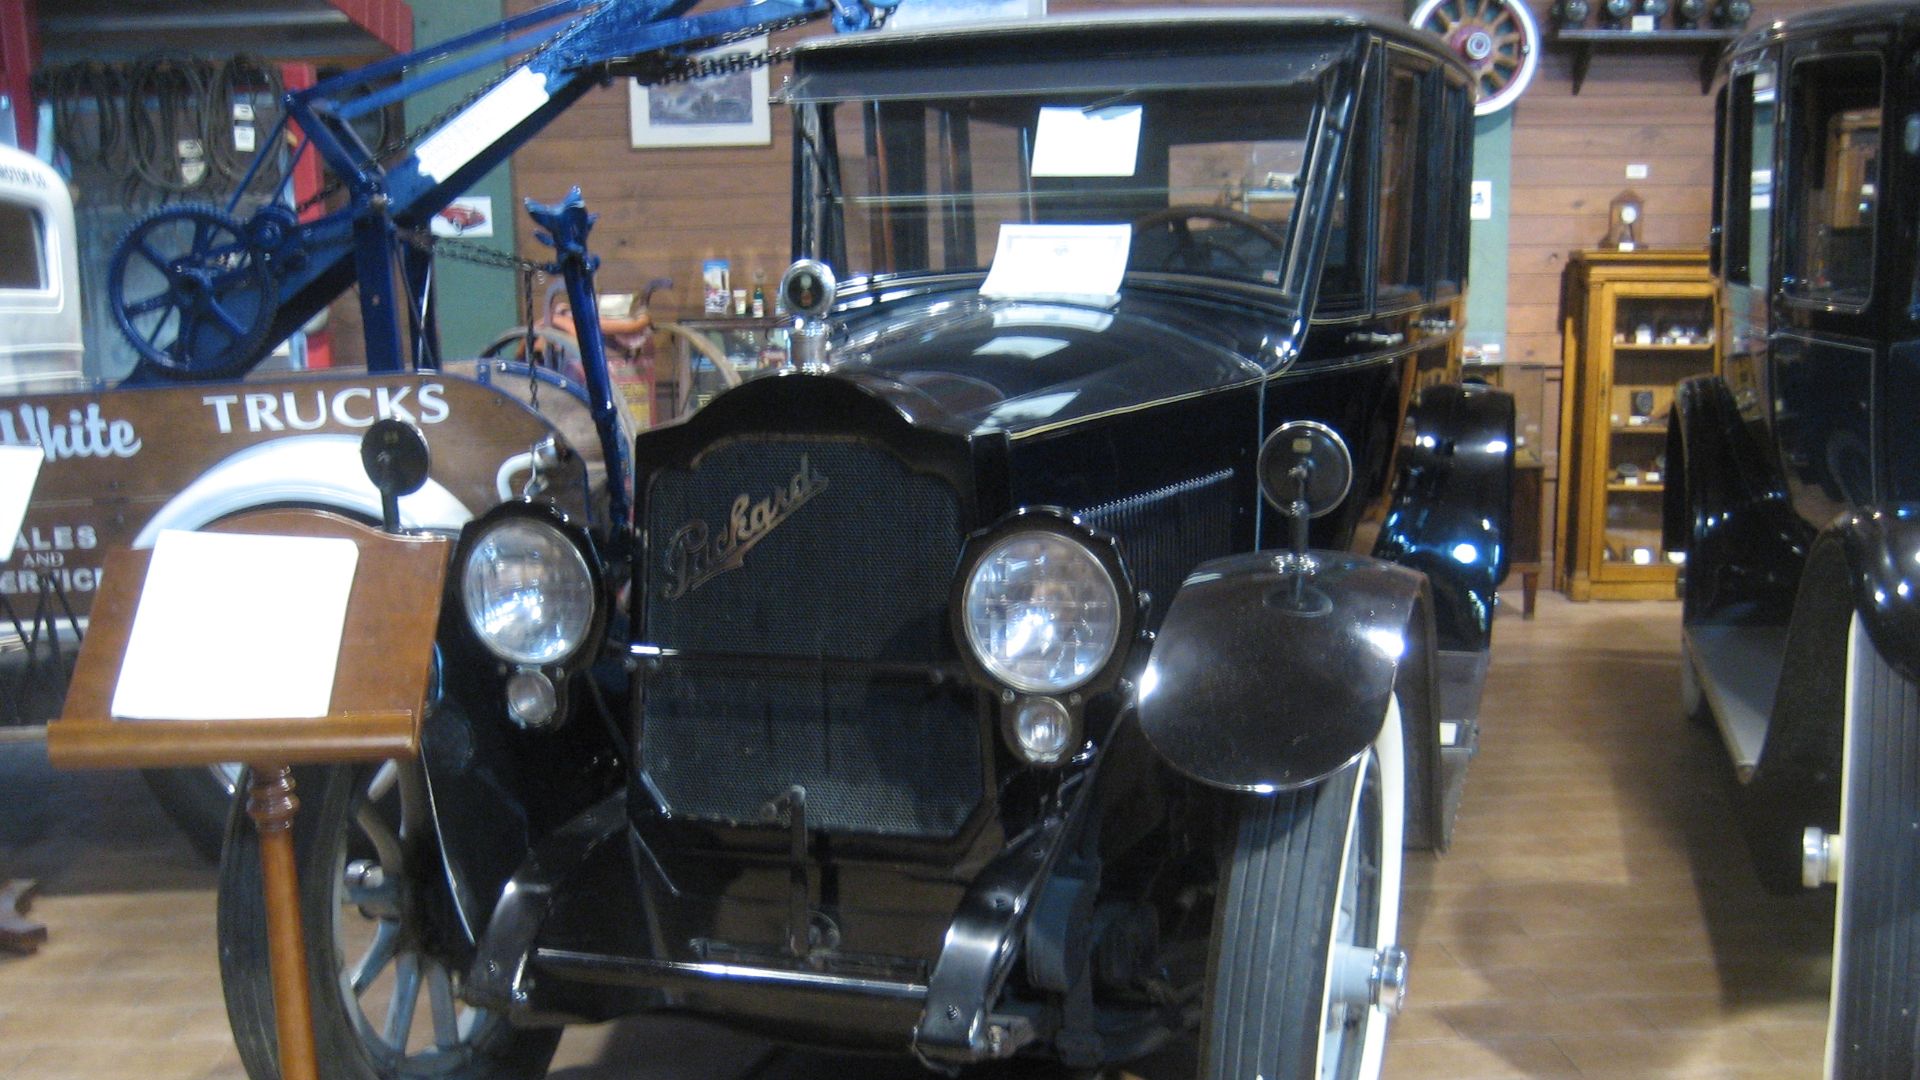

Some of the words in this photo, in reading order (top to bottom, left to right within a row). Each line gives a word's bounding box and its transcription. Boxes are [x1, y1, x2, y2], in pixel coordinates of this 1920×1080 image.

[202, 384, 450, 434] TRUCKS
[15, 525, 98, 551] ALES
[660, 451, 830, 601] Packard
[23, 552, 65, 568] AND
[0, 567, 103, 594] ERVIC
